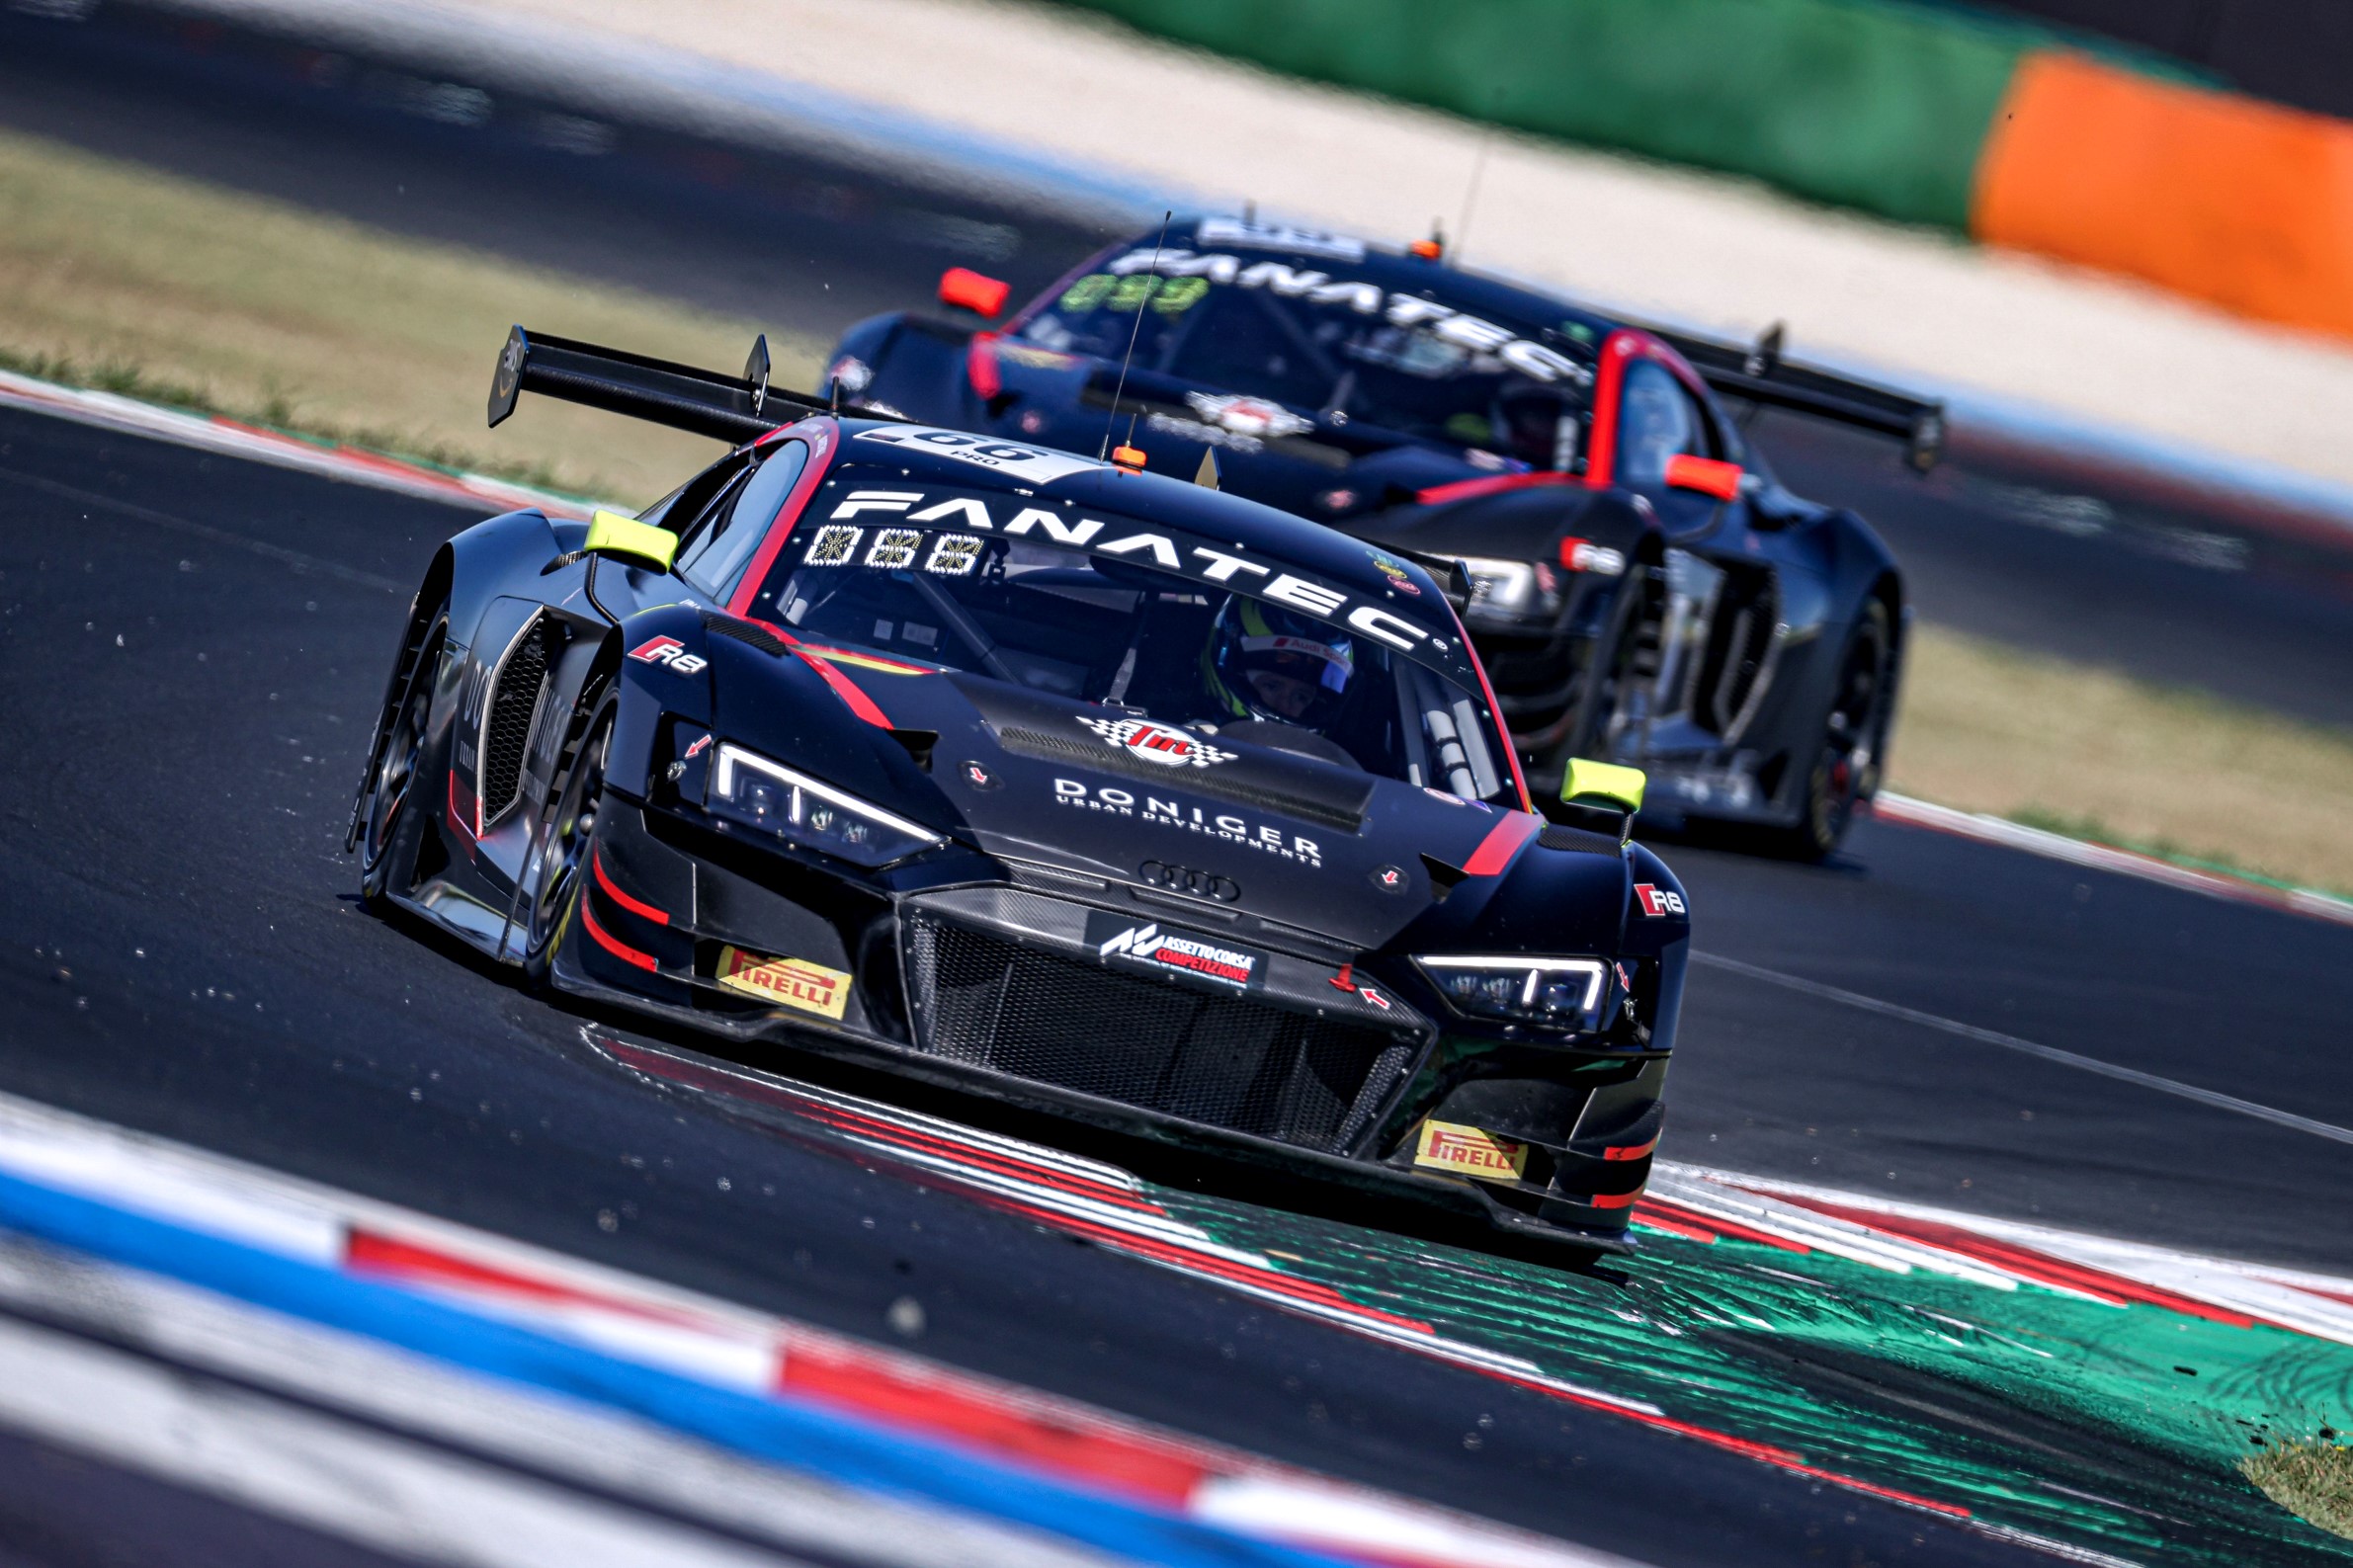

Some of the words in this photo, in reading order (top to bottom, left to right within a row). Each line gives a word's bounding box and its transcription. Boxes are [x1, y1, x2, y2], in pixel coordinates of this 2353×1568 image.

[1108, 247, 1579, 382] FANATEC
[913, 432, 1050, 461] 66
[950, 451, 1000, 465] PRO
[829, 490, 1429, 651] FANATEC
[637, 640, 708, 674] R8
[1053, 779, 1322, 859] DONIGER
[1055, 795, 1133, 816] URBAN
[1141, 810, 1322, 868] DEVELOPMENTS
[1642, 888, 1686, 915] R8
[1154, 948, 1251, 982] COMPETIZIONE
[1162, 937, 1214, 960] ASSETTO
[1214, 949, 1252, 970] CORSA
[728, 949, 836, 1006] PIRELLI
[1428, 1130, 1519, 1171] PIRELLI
